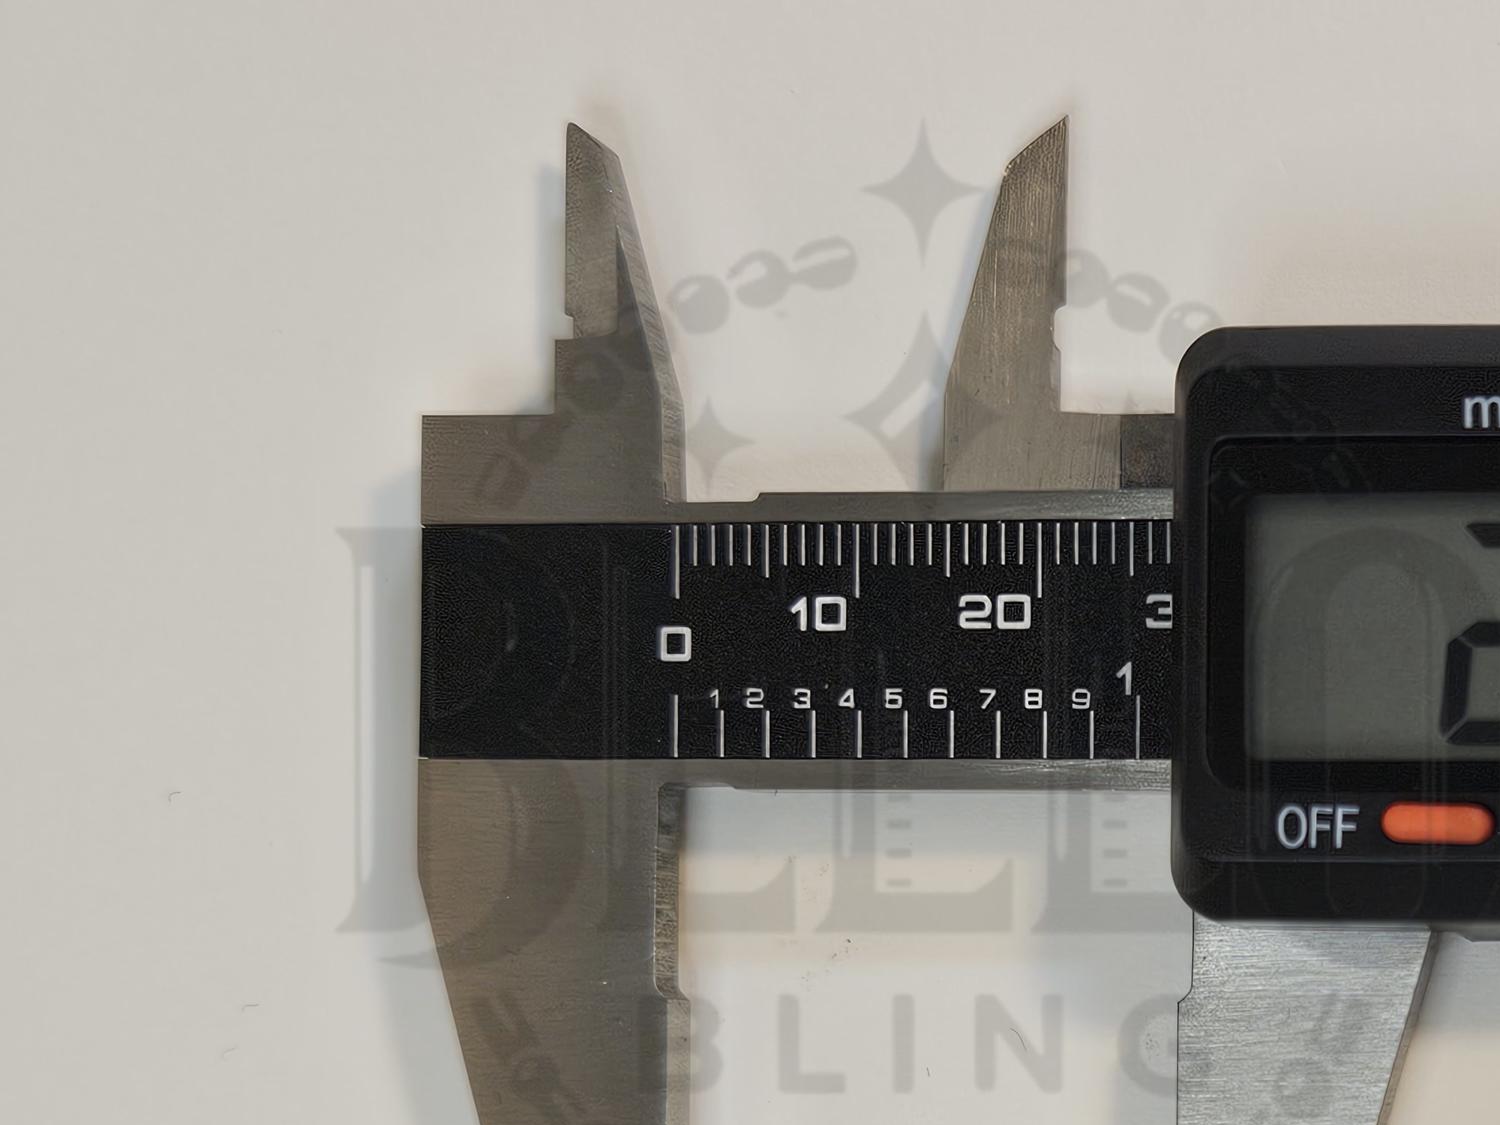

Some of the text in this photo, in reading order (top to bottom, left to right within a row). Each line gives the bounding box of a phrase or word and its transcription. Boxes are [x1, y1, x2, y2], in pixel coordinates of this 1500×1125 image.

[660, 626, 692, 661] 0
[790, 596, 846, 631] 10
[959, 594, 1031, 629] 20
[710, 662, 1131, 709] 1 2 3 4 5 6 7 8 9 1
[1278, 806, 1359, 848] OFF
